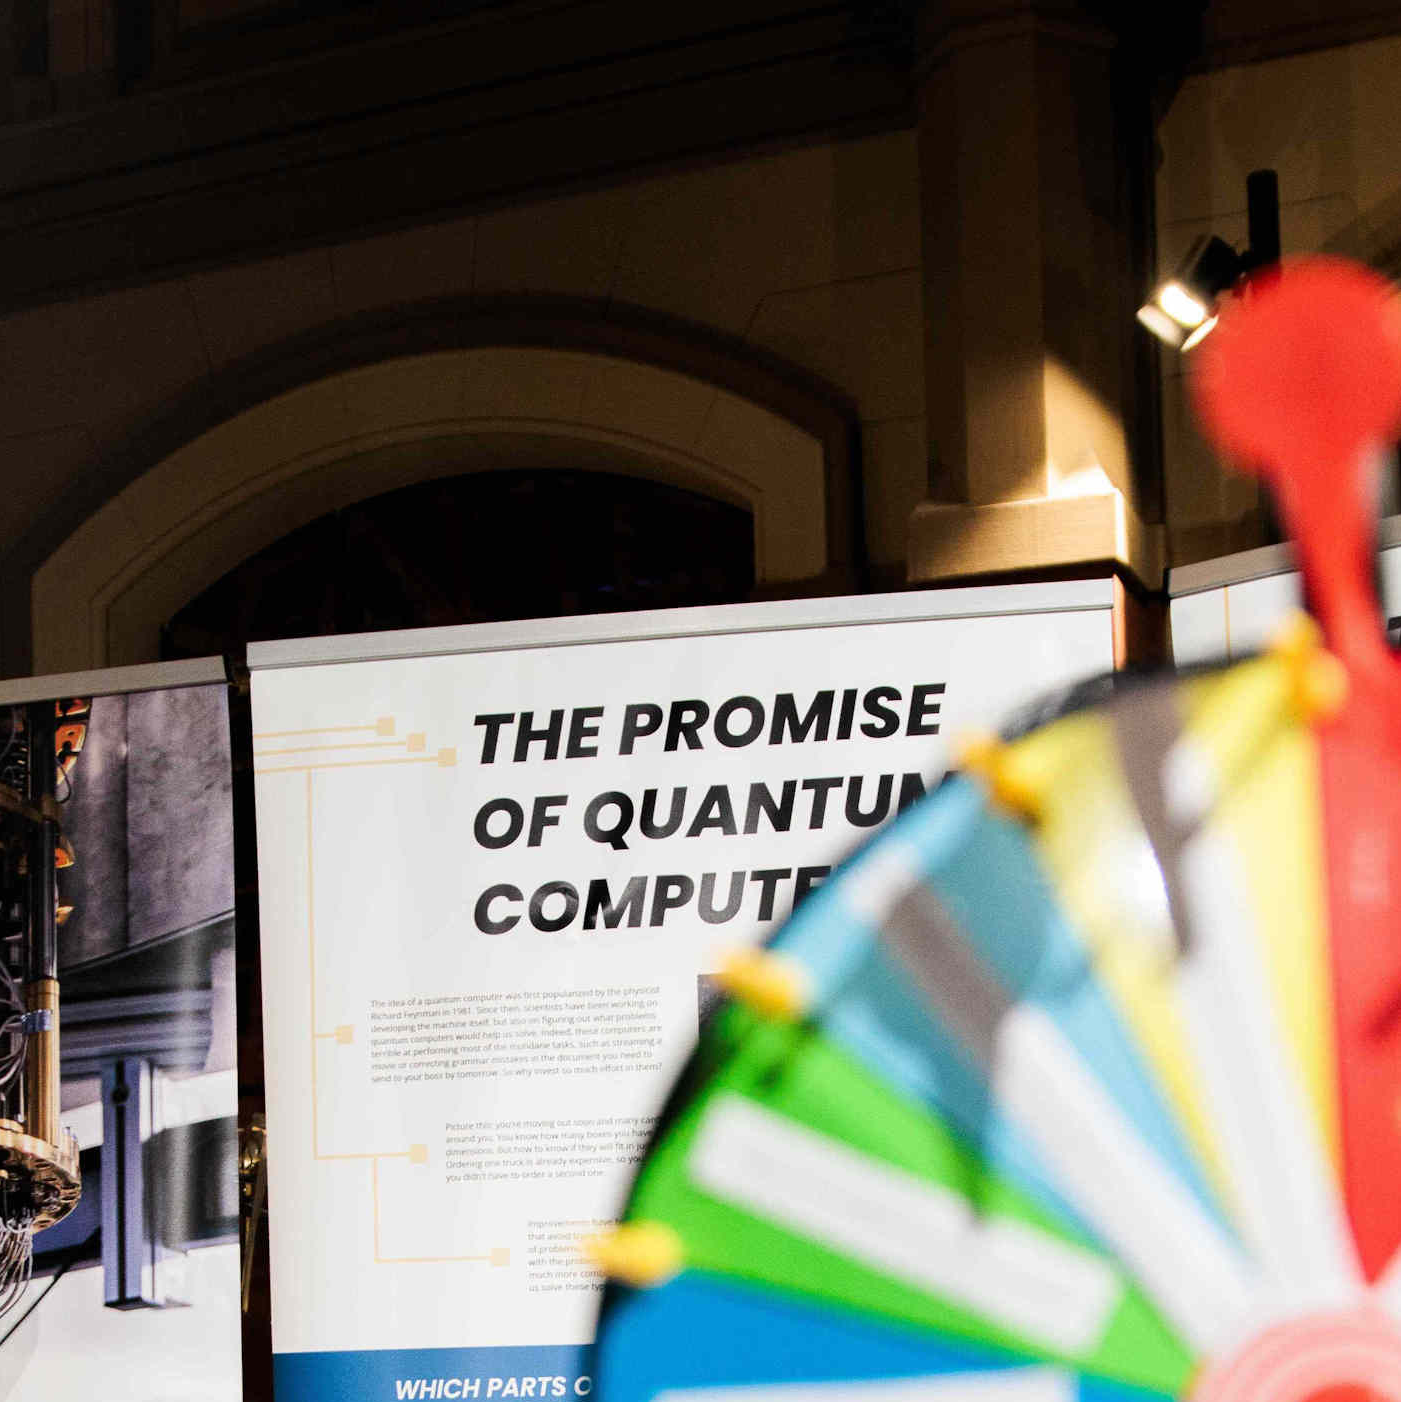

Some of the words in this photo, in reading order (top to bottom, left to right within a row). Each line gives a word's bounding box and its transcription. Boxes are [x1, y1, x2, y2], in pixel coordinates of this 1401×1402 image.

[473, 706, 604, 764] THE
[618, 682, 946, 756] PROMISE
[473, 795, 569, 849] OF
[395, 1378, 481, 1400] WHICH
[487, 1376, 567, 1398] PARTS
